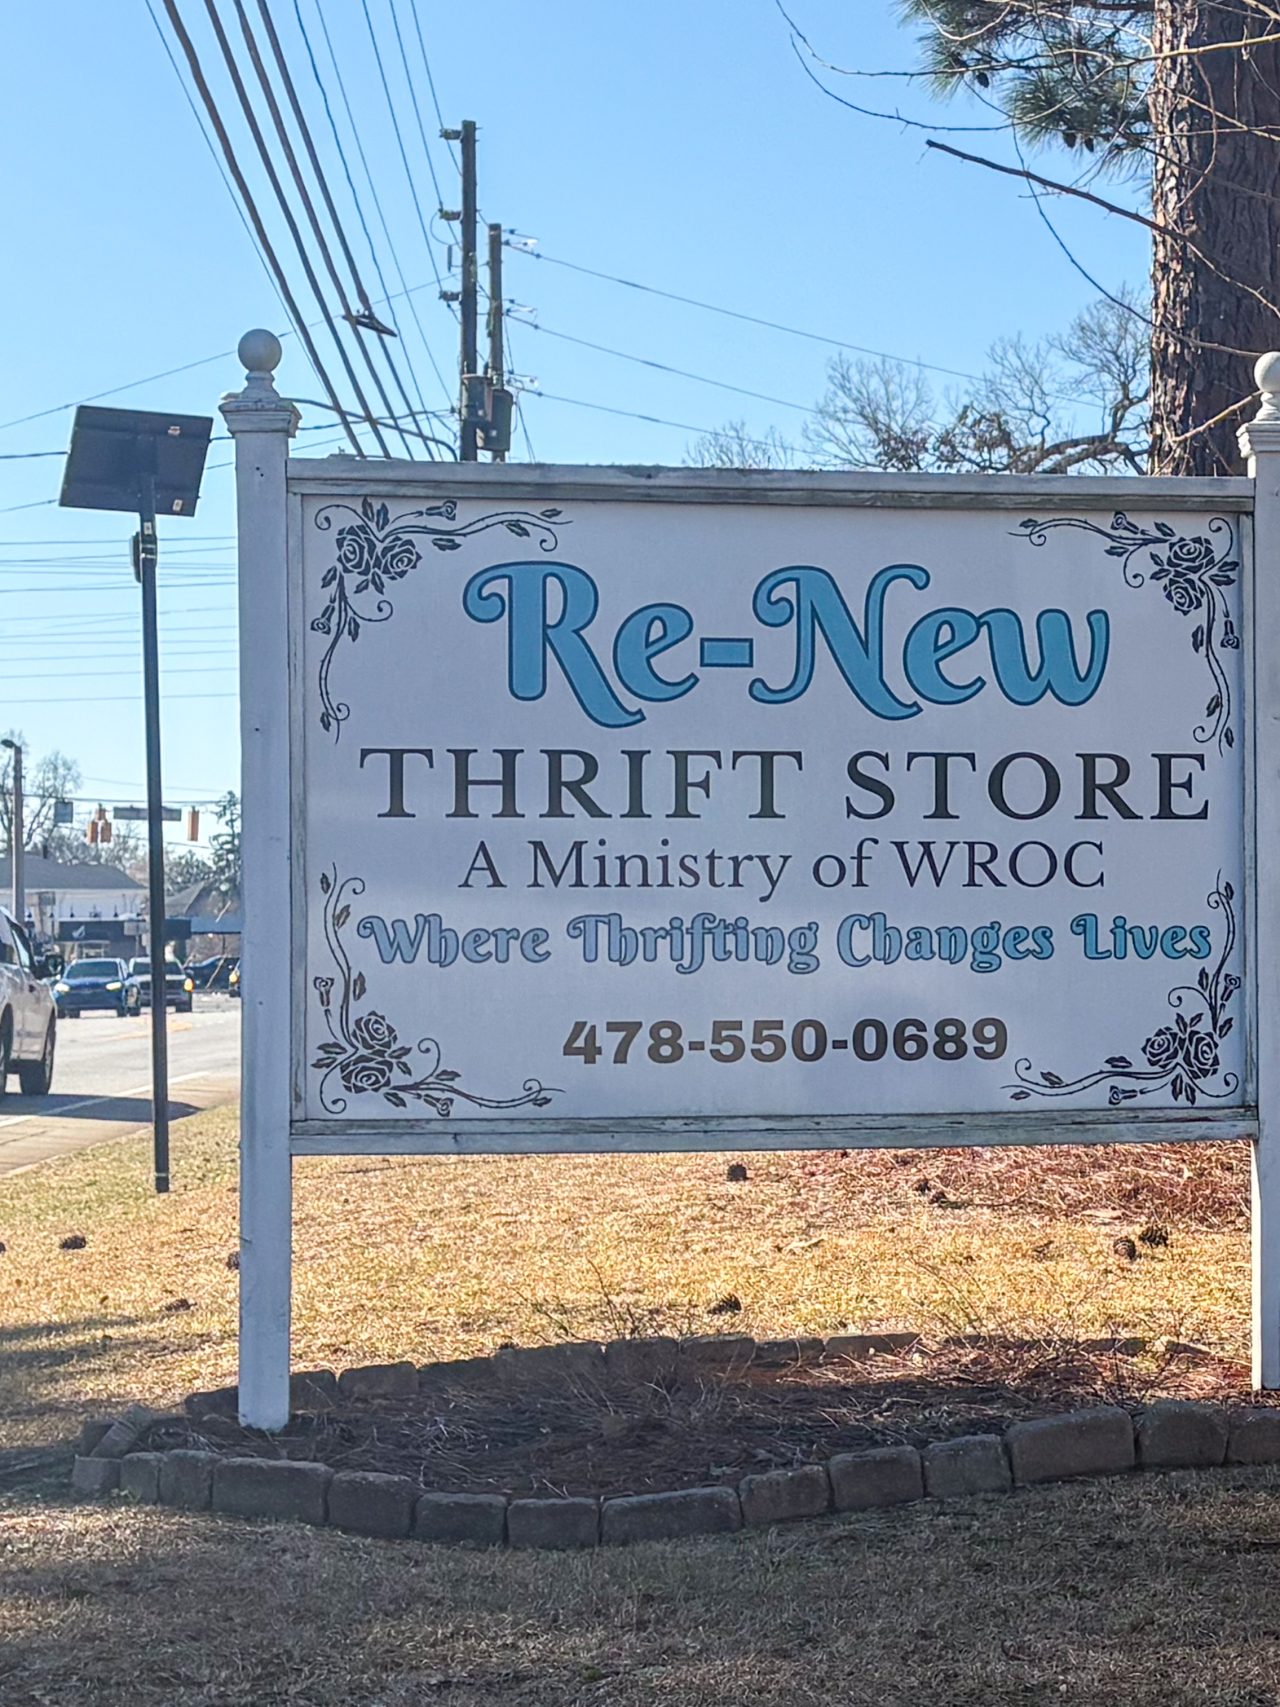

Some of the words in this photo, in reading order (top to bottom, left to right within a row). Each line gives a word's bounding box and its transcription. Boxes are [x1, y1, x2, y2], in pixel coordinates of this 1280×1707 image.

[462, 560, 1110, 729] Re-New
[359, 747, 804, 820] THRIFT
[845, 750, 1210, 822] STORE
[457, 840, 508, 889] A
[527, 838, 793, 903] Ministry
[812, 837, 880, 888] of
[889, 840, 1105, 889] WROC
[356, 912, 552, 969] Where
[566, 911, 821, 975] Thrifting
[836, 911, 1056, 974] Changes
[1069, 912, 1212, 962] Lives
[562, 1017, 1008, 1065] 478-550-0689
